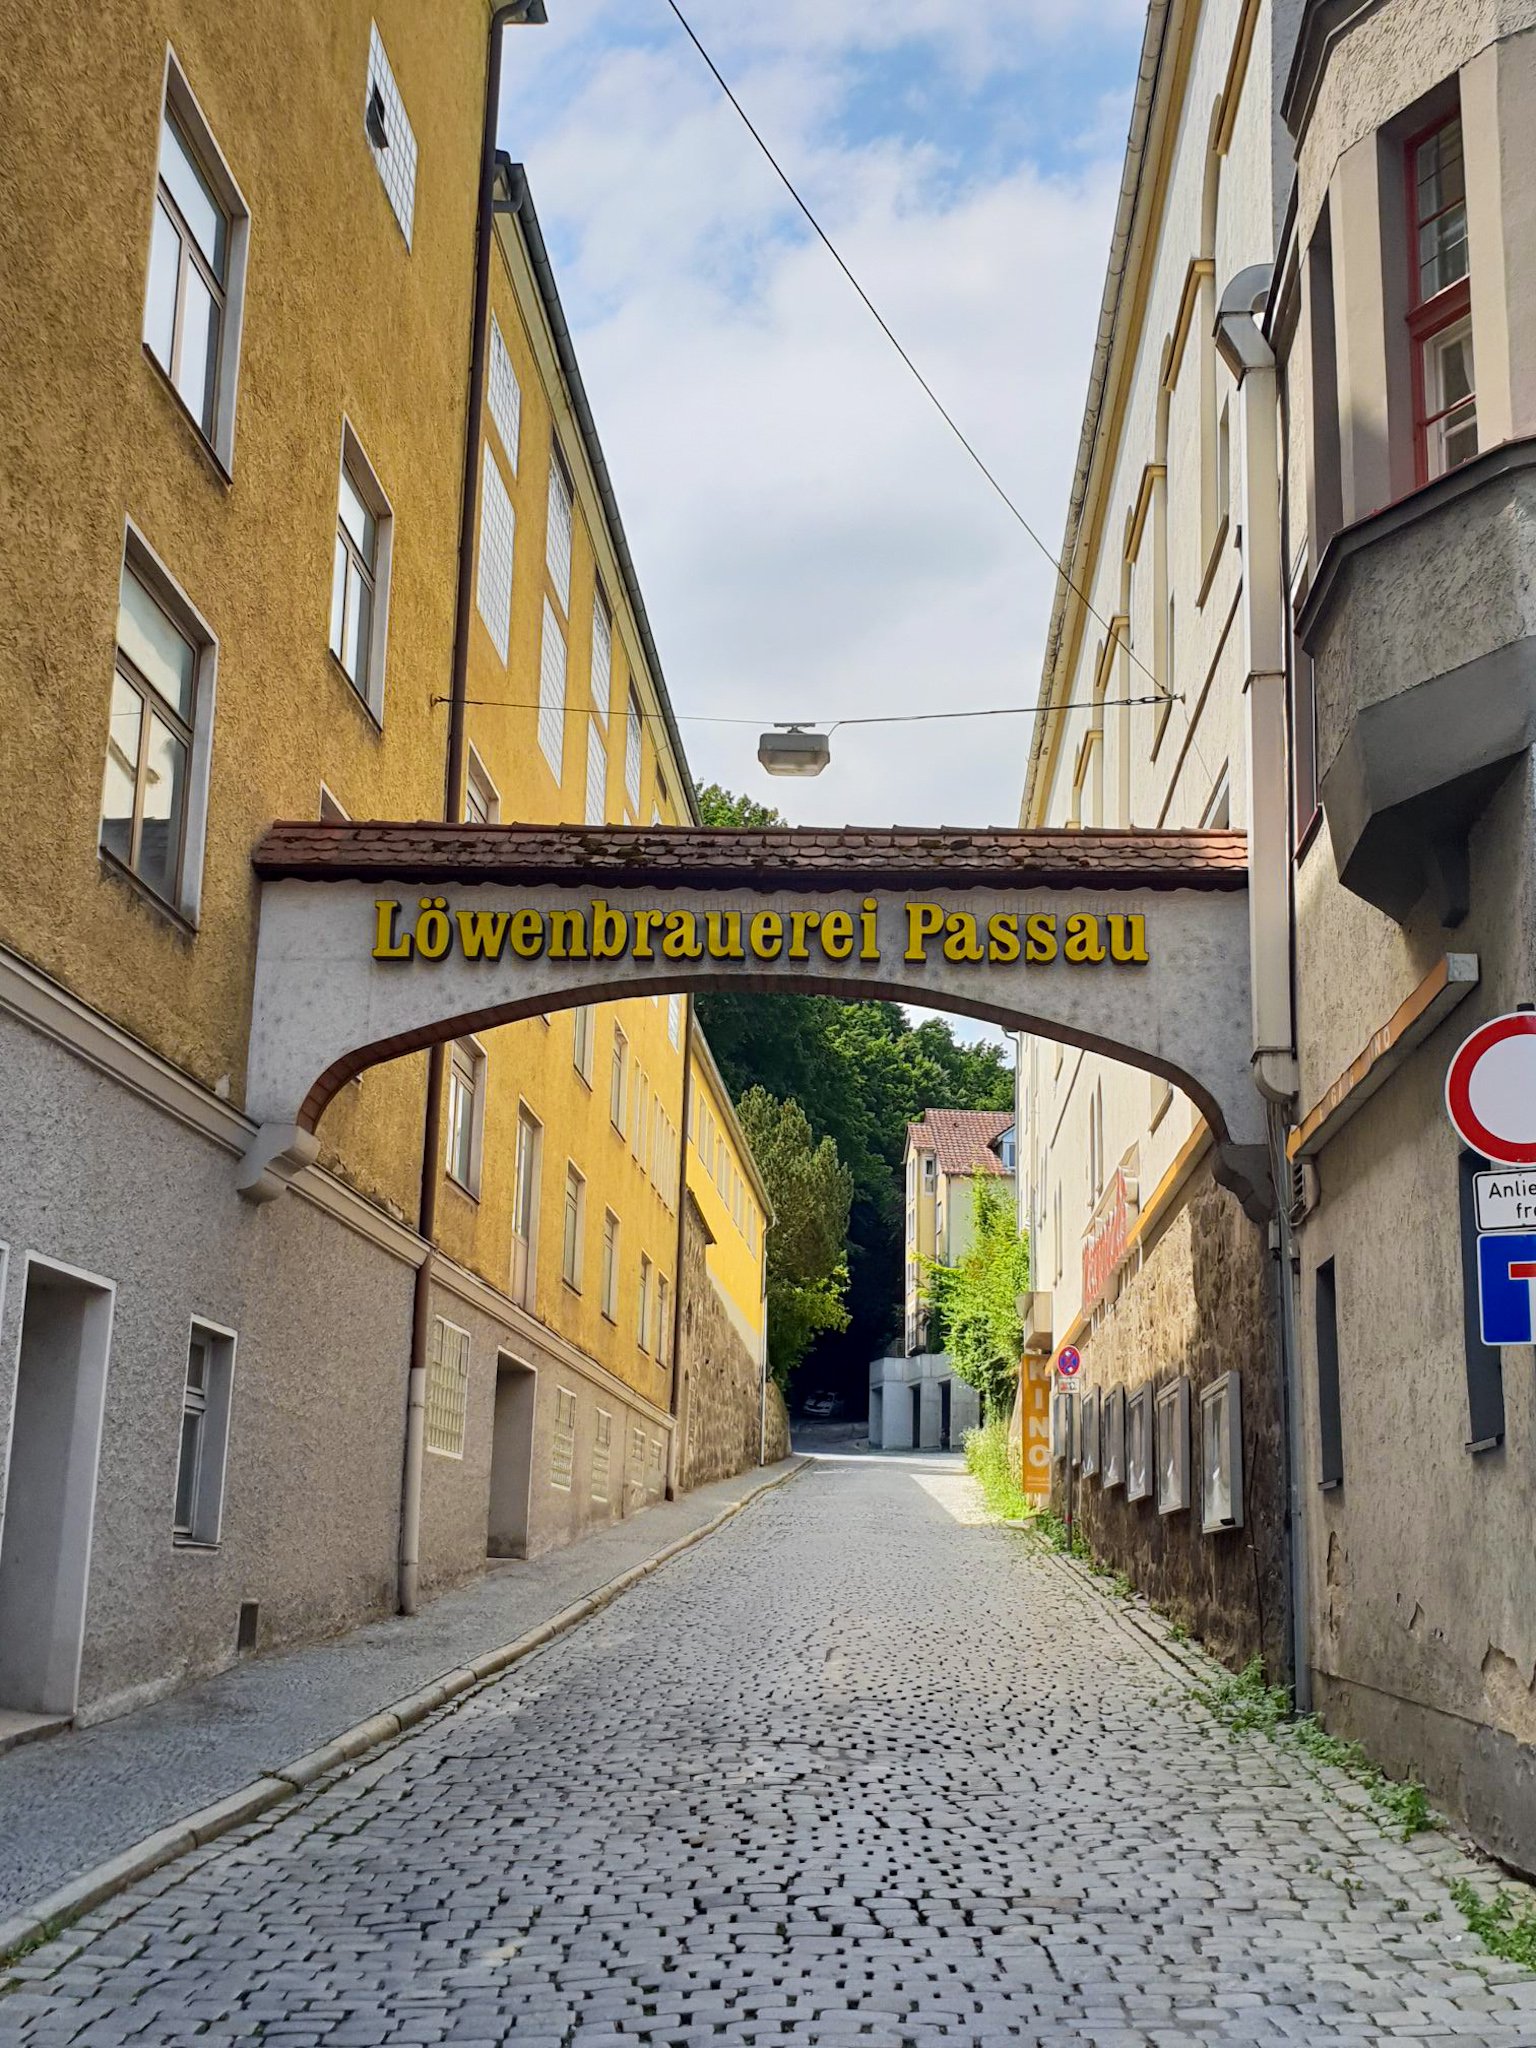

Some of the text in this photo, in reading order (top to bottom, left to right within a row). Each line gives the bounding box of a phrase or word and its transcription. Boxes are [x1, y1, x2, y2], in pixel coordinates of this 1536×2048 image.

[371, 897, 1151, 964] Löwenbrauerei Passau
[1516, 1202, 1536, 1219] fr
[1028, 1359, 1051, 1468] KINO
